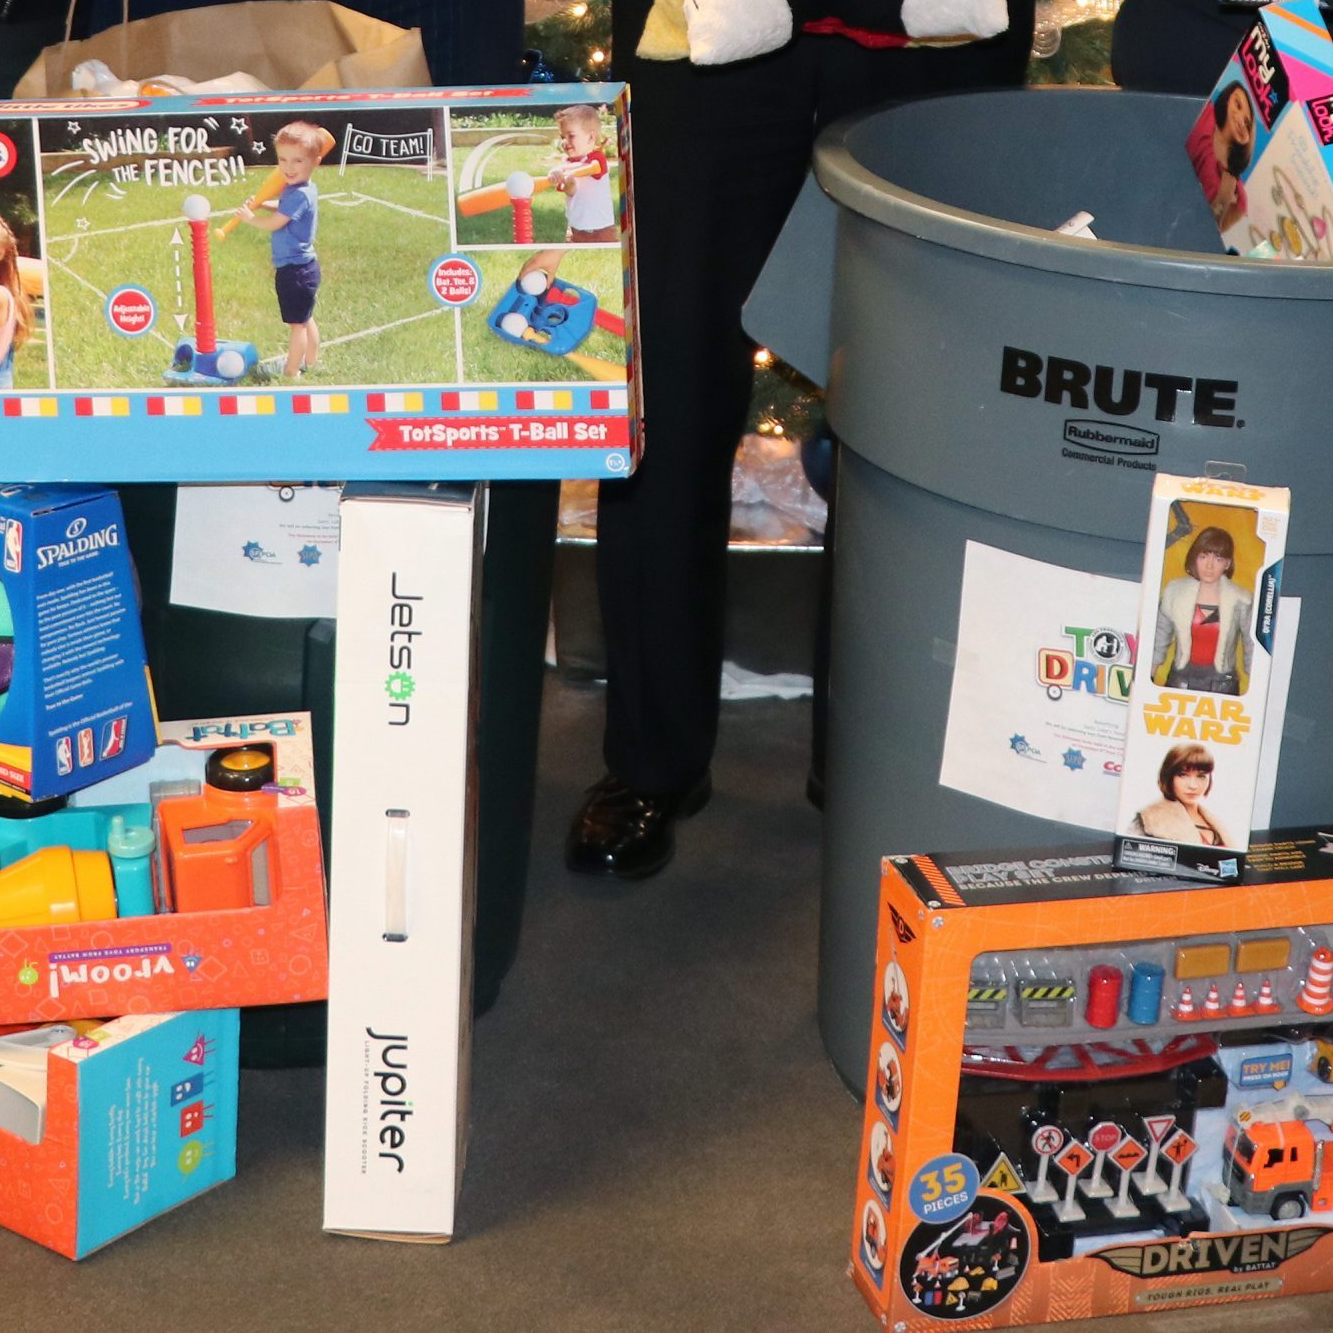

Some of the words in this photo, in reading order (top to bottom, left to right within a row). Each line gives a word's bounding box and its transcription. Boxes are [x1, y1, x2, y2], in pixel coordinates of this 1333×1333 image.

[167, 126, 211, 154] FOR
[352, 134, 373, 154] GO
[380, 137, 425, 157] TEAM!
[112, 163, 140, 183] THE
[144, 155, 247, 187] FENCES!!
[438, 267, 473, 277] Includes:
[113, 304, 151, 315] Adjustable
[999, 345, 1239, 429] BRUTE
[399, 424, 501, 446] TotSports
[509, 422, 569, 441] T-Ball
[573, 423, 608, 441] Set
[1067, 426, 1155, 449] Rubbermaid
[1061, 448, 1115, 466] Commercial
[1118, 457, 1157, 471] Products
[36, 523, 119, 570] SPALDING
[384, 572, 424, 726] Jetson
[1038, 651, 1133, 702] DRIV
[1143, 692, 1251, 724] STAR
[184, 719, 297, 742] Battat
[1142, 711, 1251, 746] WARS
[1138, 843, 1176, 856] WARNING:
[946, 860, 1025, 876] BRIDGE
[952, 871, 1012, 885] PLAY
[1014, 867, 1056, 881] SET
[958, 879, 1023, 891] BECAUSE
[1026, 877, 1051, 886] THE
[1053, 874, 1091, 884] CREW
[49, 955, 175, 999] vroom!
[1244, 1063, 1266, 1074] TRY
[1270, 1059, 1291, 1071] ME!
[1093, 1132, 1118, 1143] STOP
[919, 1161, 966, 1202] 35
[923, 1190, 969, 1216] PIECES
[1146, 1231, 1287, 1275] DRIVEN
[1245, 1262, 1276, 1272] BATTAT
[1147, 1289, 1183, 1301] TOUGH
[1217, 1284, 1242, 1294] REAL
[1245, 1281, 1270, 1291] PLAY
